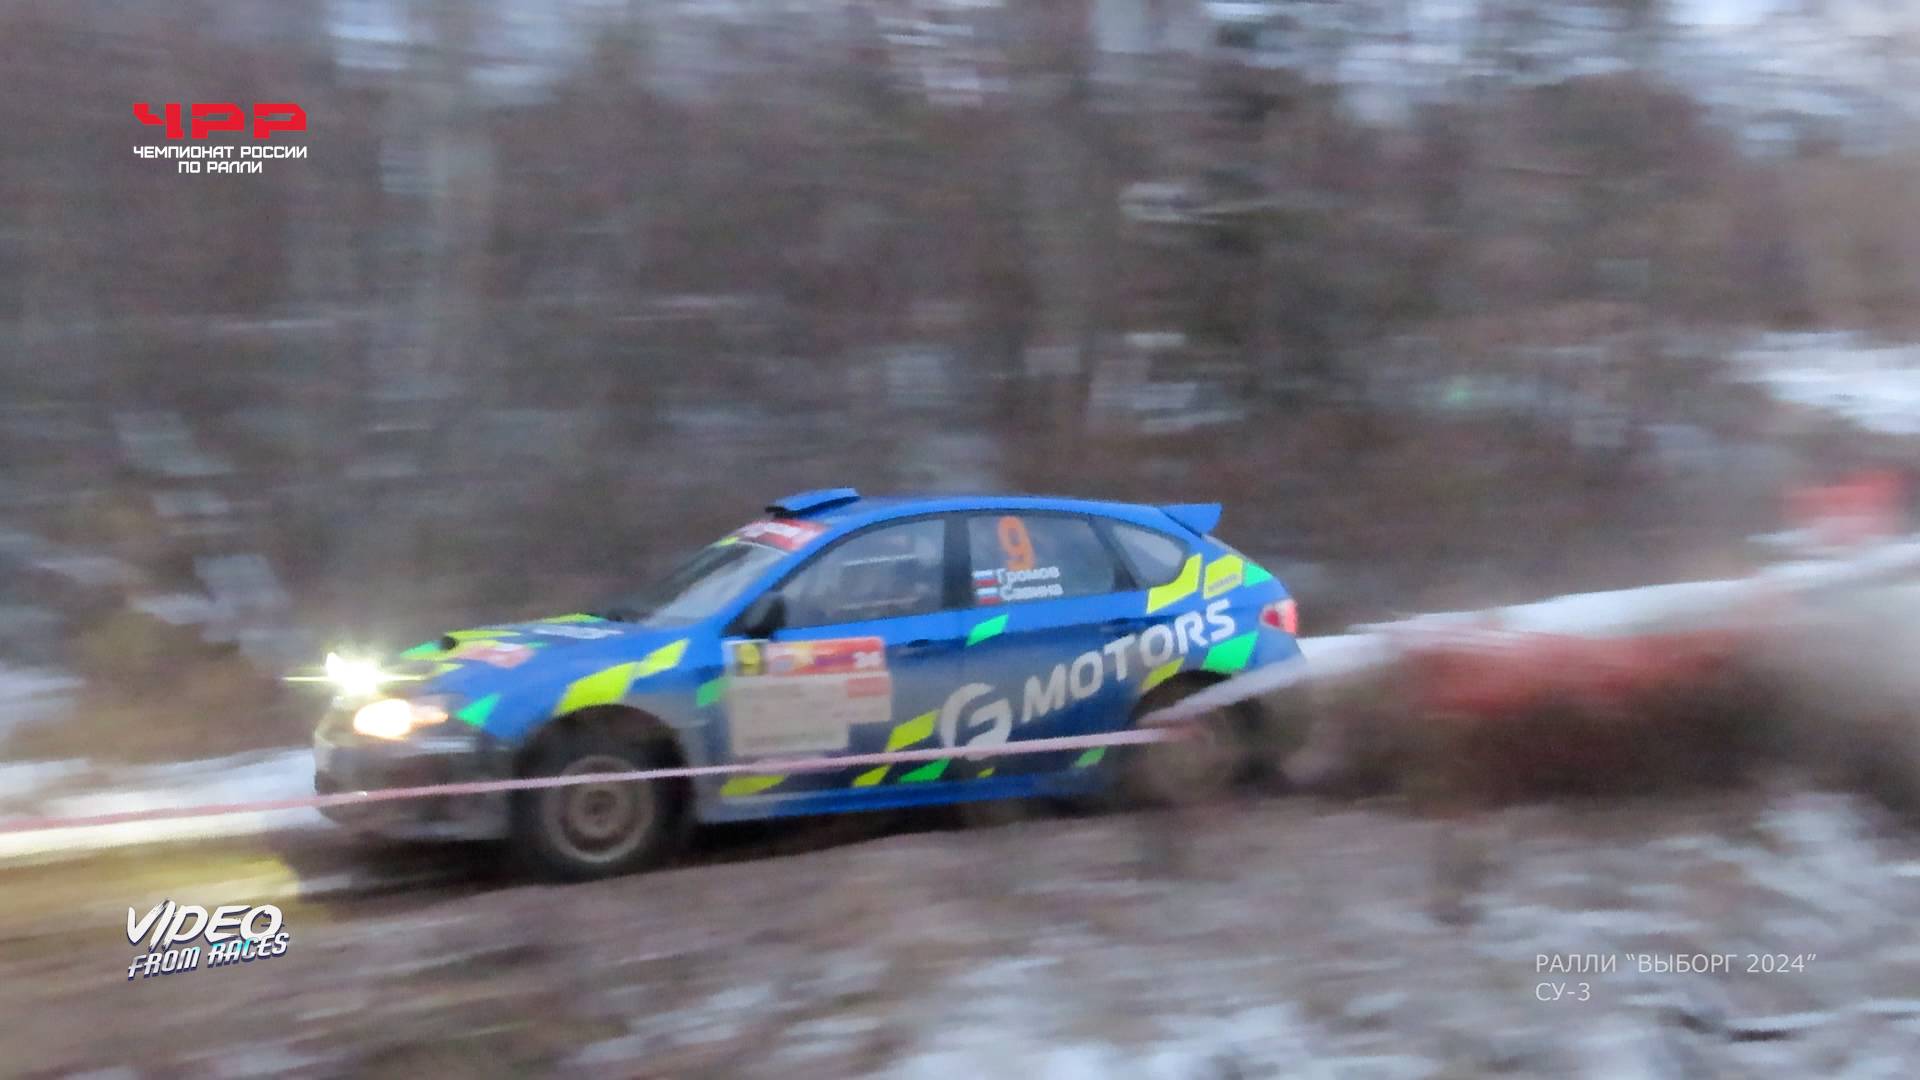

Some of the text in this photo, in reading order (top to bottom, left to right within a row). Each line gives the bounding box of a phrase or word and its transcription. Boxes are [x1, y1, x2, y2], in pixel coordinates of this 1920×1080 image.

[997, 515, 1036, 573] 9
[996, 566, 1060, 590] Громов
[1020, 598, 1236, 723] MOTORS
